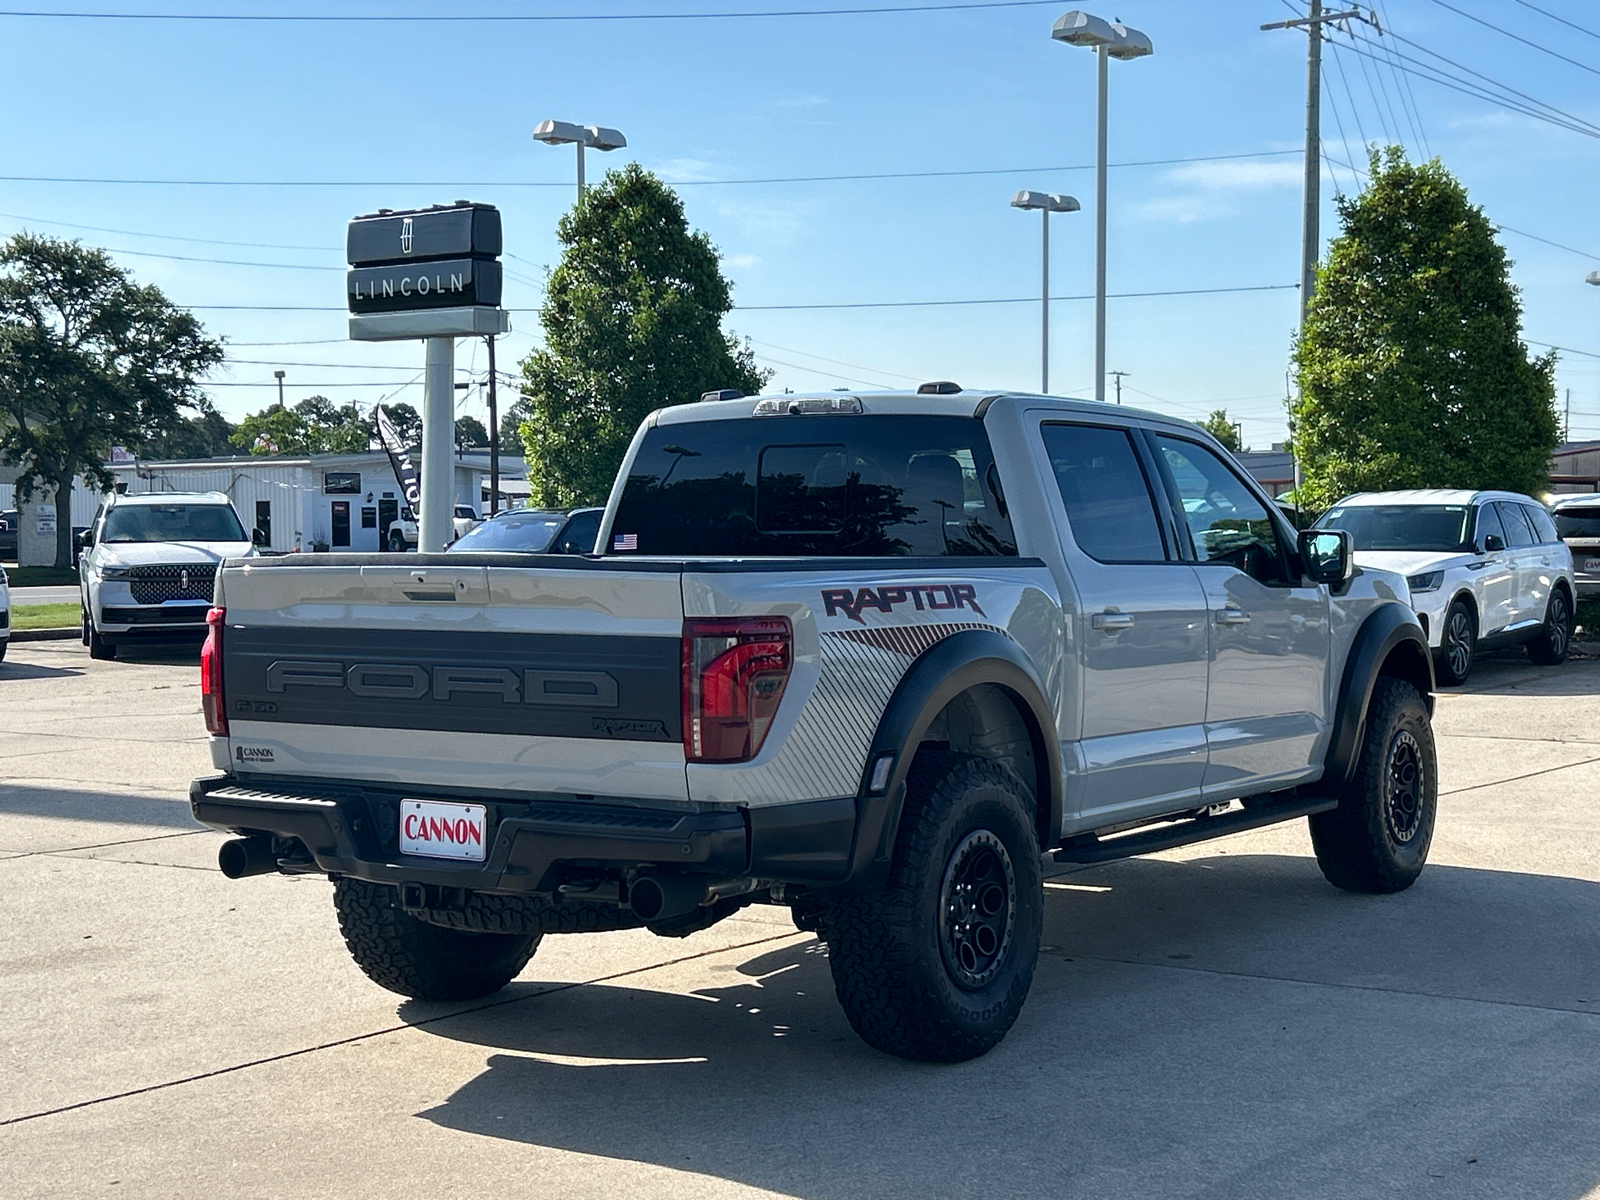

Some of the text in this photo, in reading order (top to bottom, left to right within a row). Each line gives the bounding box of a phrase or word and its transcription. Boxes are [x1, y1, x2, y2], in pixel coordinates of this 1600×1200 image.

[355, 273, 463, 300] LINCOLN
[821, 584, 987, 626] RAPTOR
[266, 660, 619, 707] FORD
[592, 717, 671, 738] RAPTOR
[405, 814, 481, 846] CANNON
